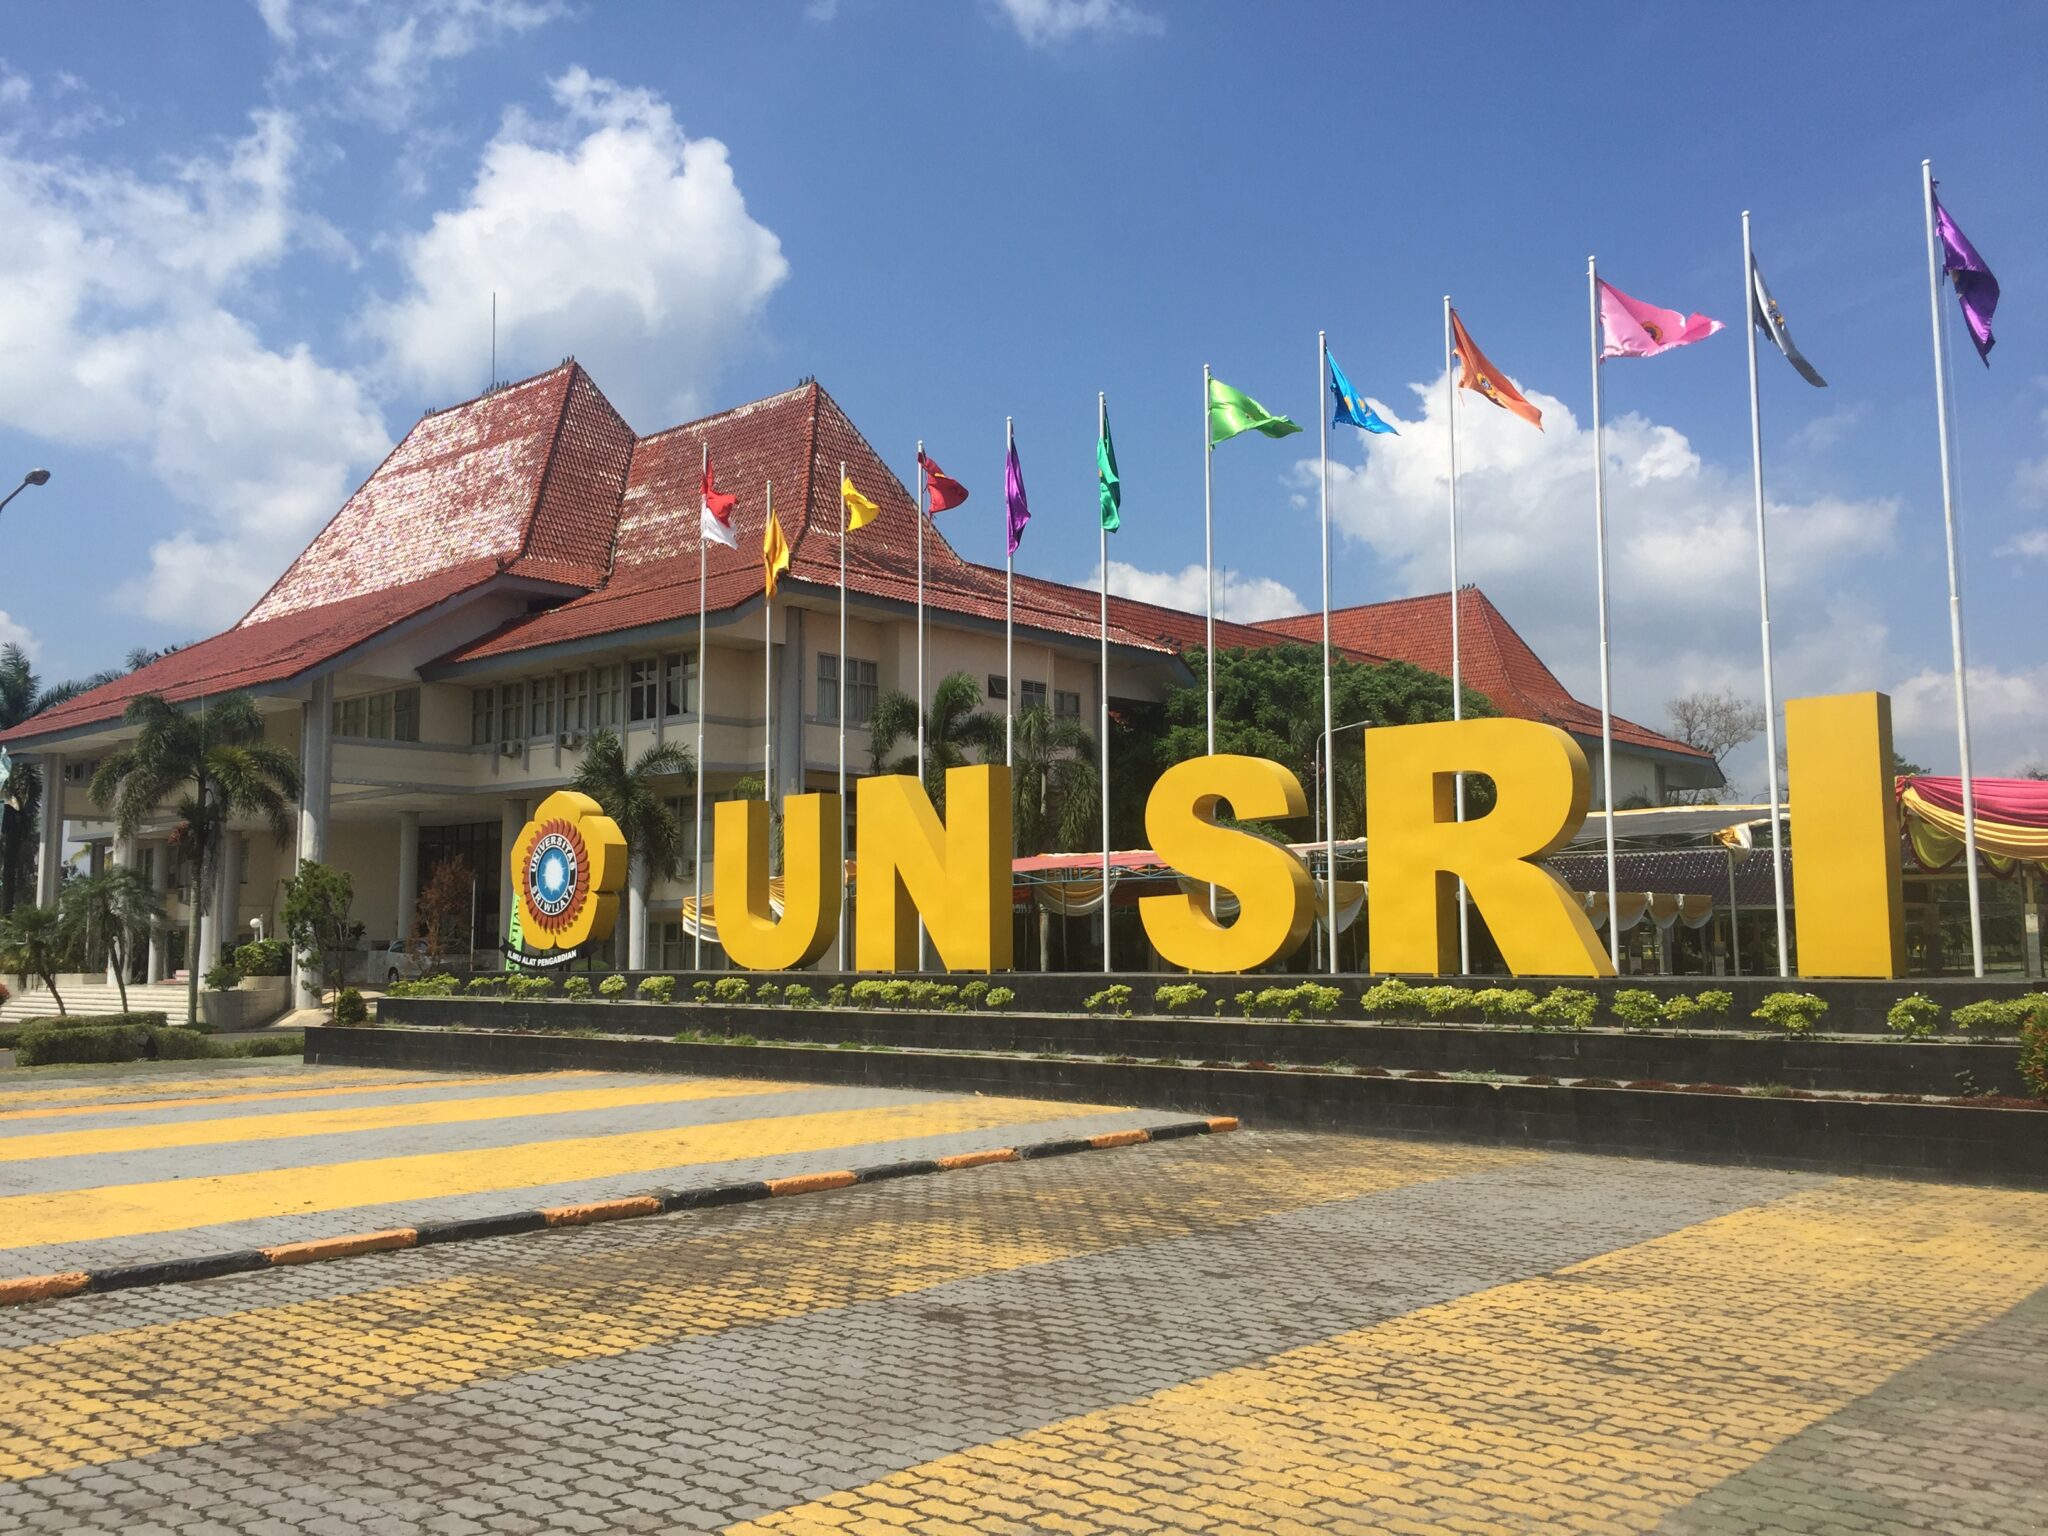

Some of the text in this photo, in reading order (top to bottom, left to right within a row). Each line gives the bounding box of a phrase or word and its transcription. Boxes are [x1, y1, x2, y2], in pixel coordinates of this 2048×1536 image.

[531, 836, 577, 872] UNIVERSITAS
[531, 885, 575, 913] SRIWIJAYA
[507, 949, 577, 967] ILMU ALAT PENGABDIAN
